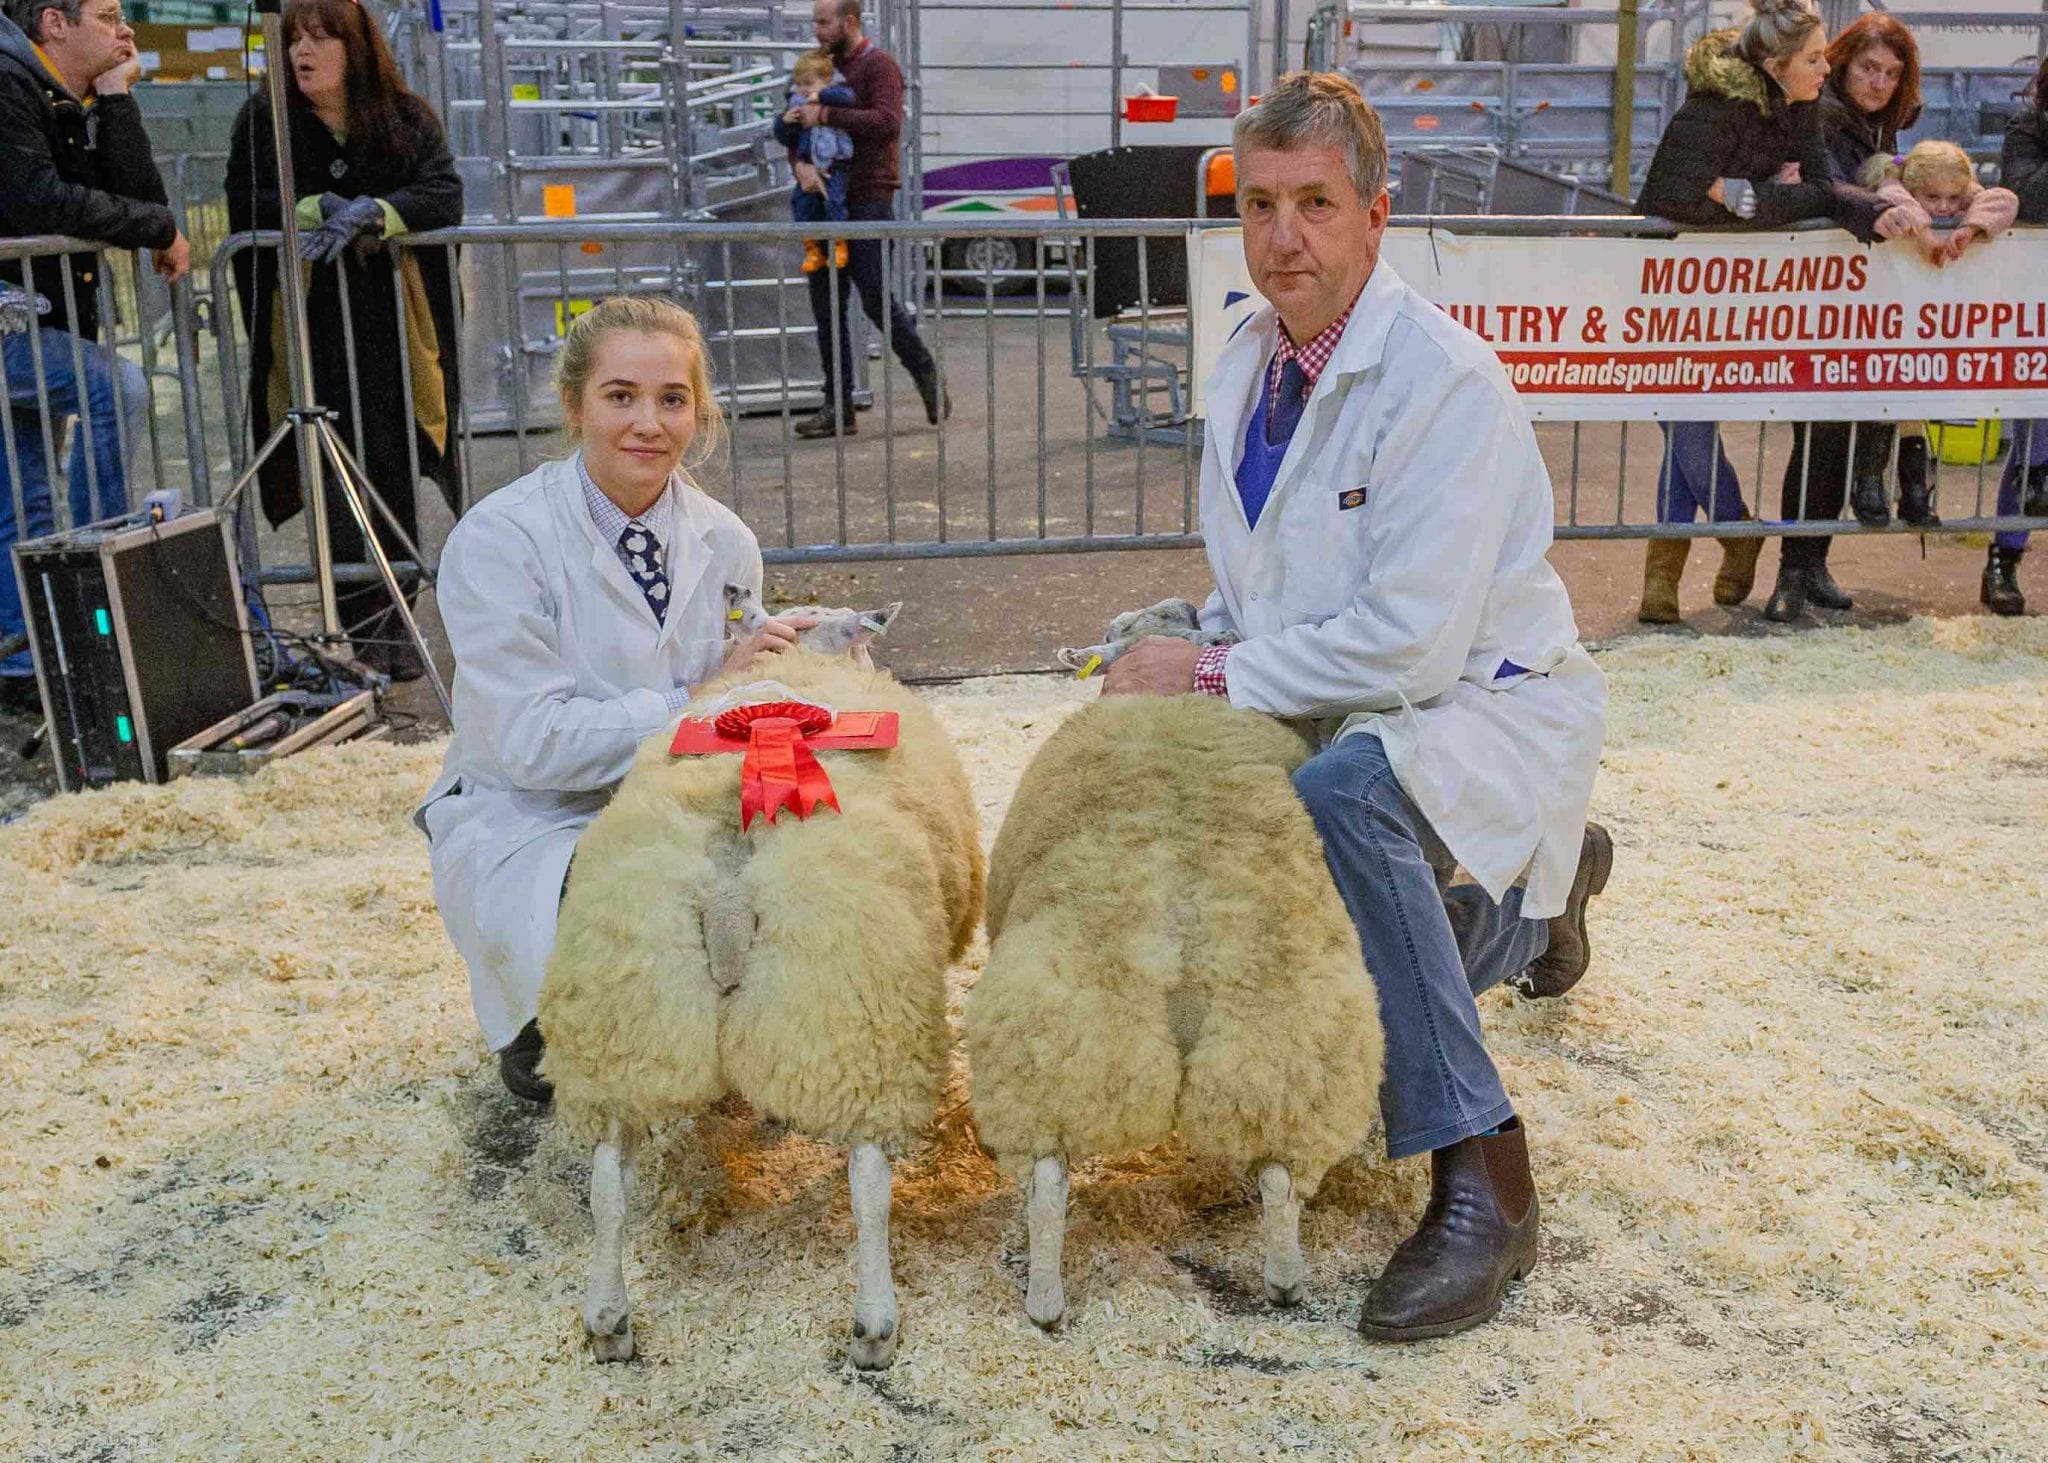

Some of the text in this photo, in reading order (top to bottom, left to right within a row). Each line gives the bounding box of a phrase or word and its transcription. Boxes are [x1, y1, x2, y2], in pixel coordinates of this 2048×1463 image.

[1641, 254, 1868, 294] MOORLANDS
[1433, 302, 2046, 343] ULTRY & SMALLHOLDING SUPPLI
[1810, 354, 1857, 384] Tel:
[1866, 353, 1948, 384] 07900
[1956, 353, 2003, 382] 671
[2014, 352, 2047, 382] 82
